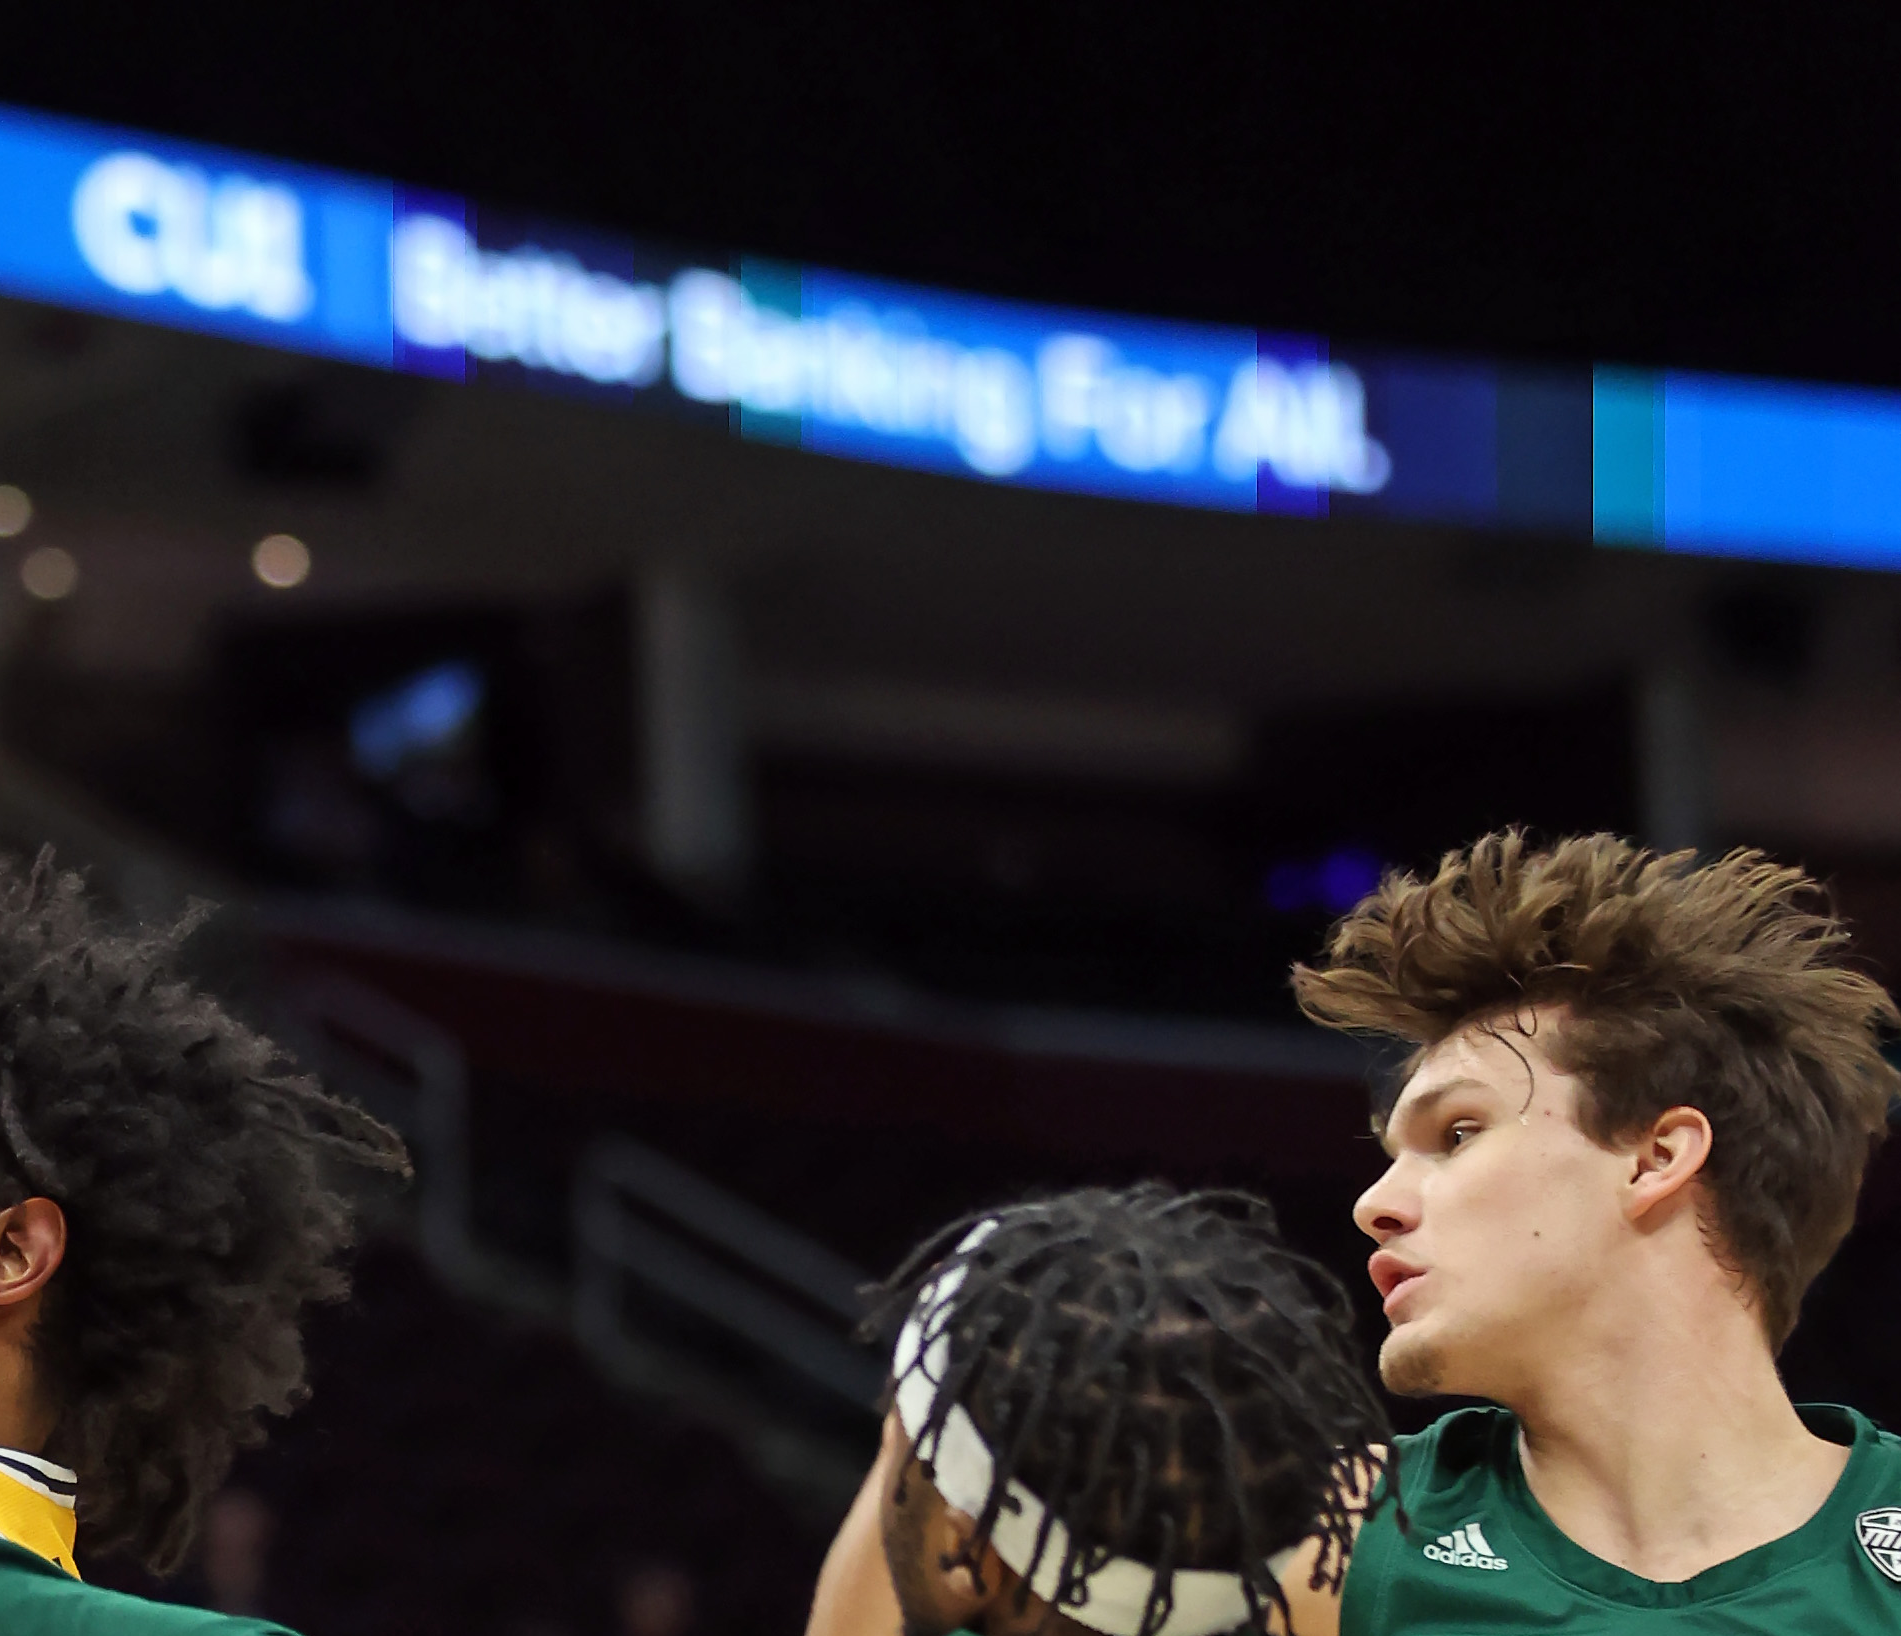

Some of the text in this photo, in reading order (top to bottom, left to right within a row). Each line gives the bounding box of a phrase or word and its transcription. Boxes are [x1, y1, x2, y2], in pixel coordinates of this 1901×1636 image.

[393, 215, 665, 388] Better
[669, 268, 1033, 477] Banking
[1036, 333, 1211, 474] For
[1422, 1543, 1509, 1571] adidas
